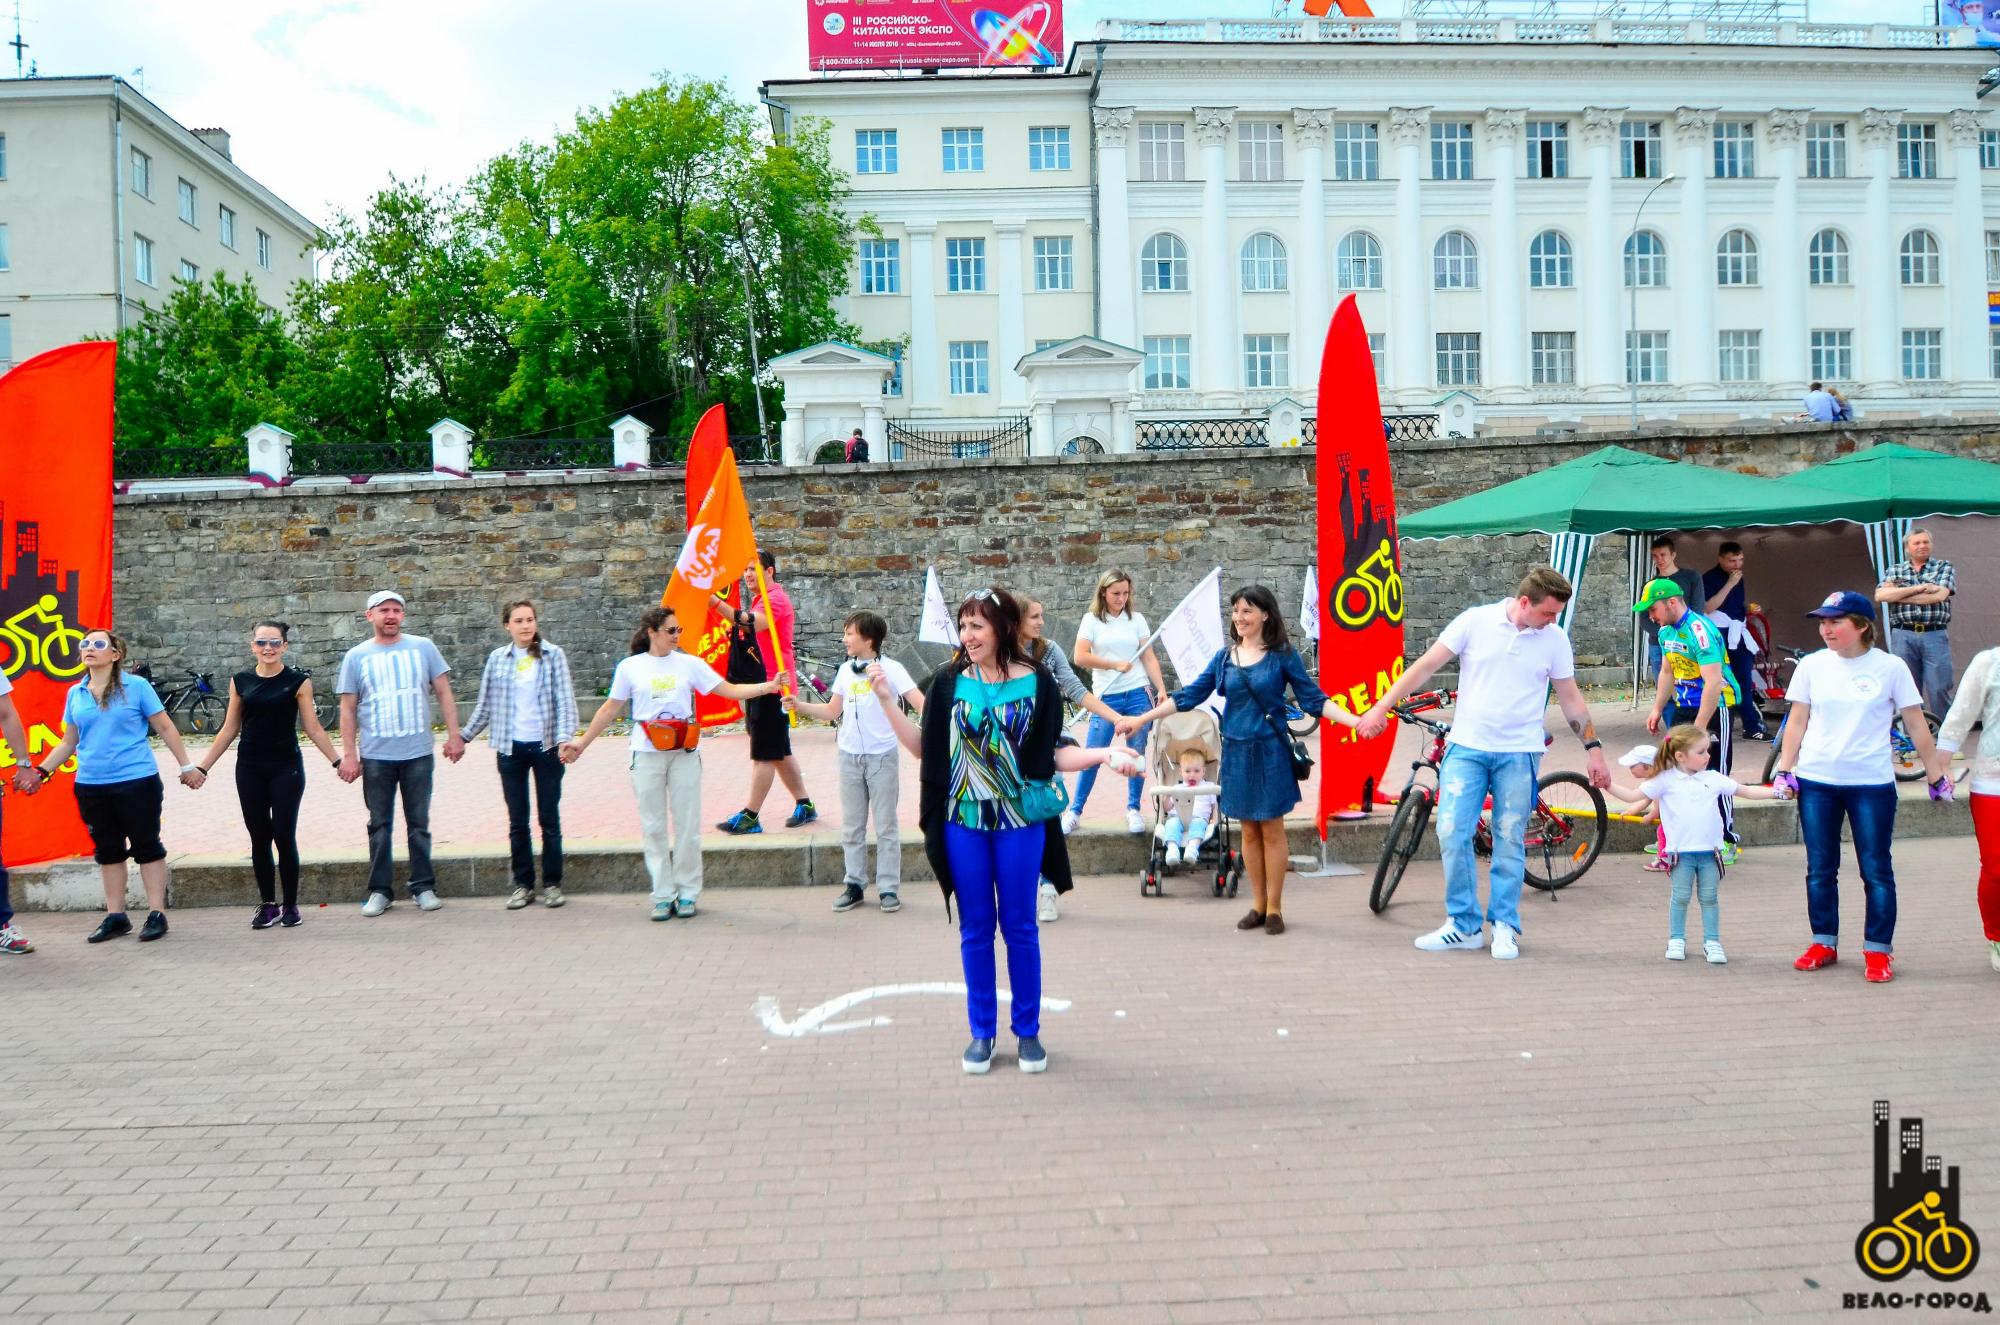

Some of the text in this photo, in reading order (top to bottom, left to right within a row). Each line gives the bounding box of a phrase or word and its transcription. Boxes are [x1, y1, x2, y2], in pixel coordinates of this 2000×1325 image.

[866, 14, 932, 25] РОССИЙСКО-
[853, 25, 953, 36] КИТАЙСКОЕ ЭКСПО
